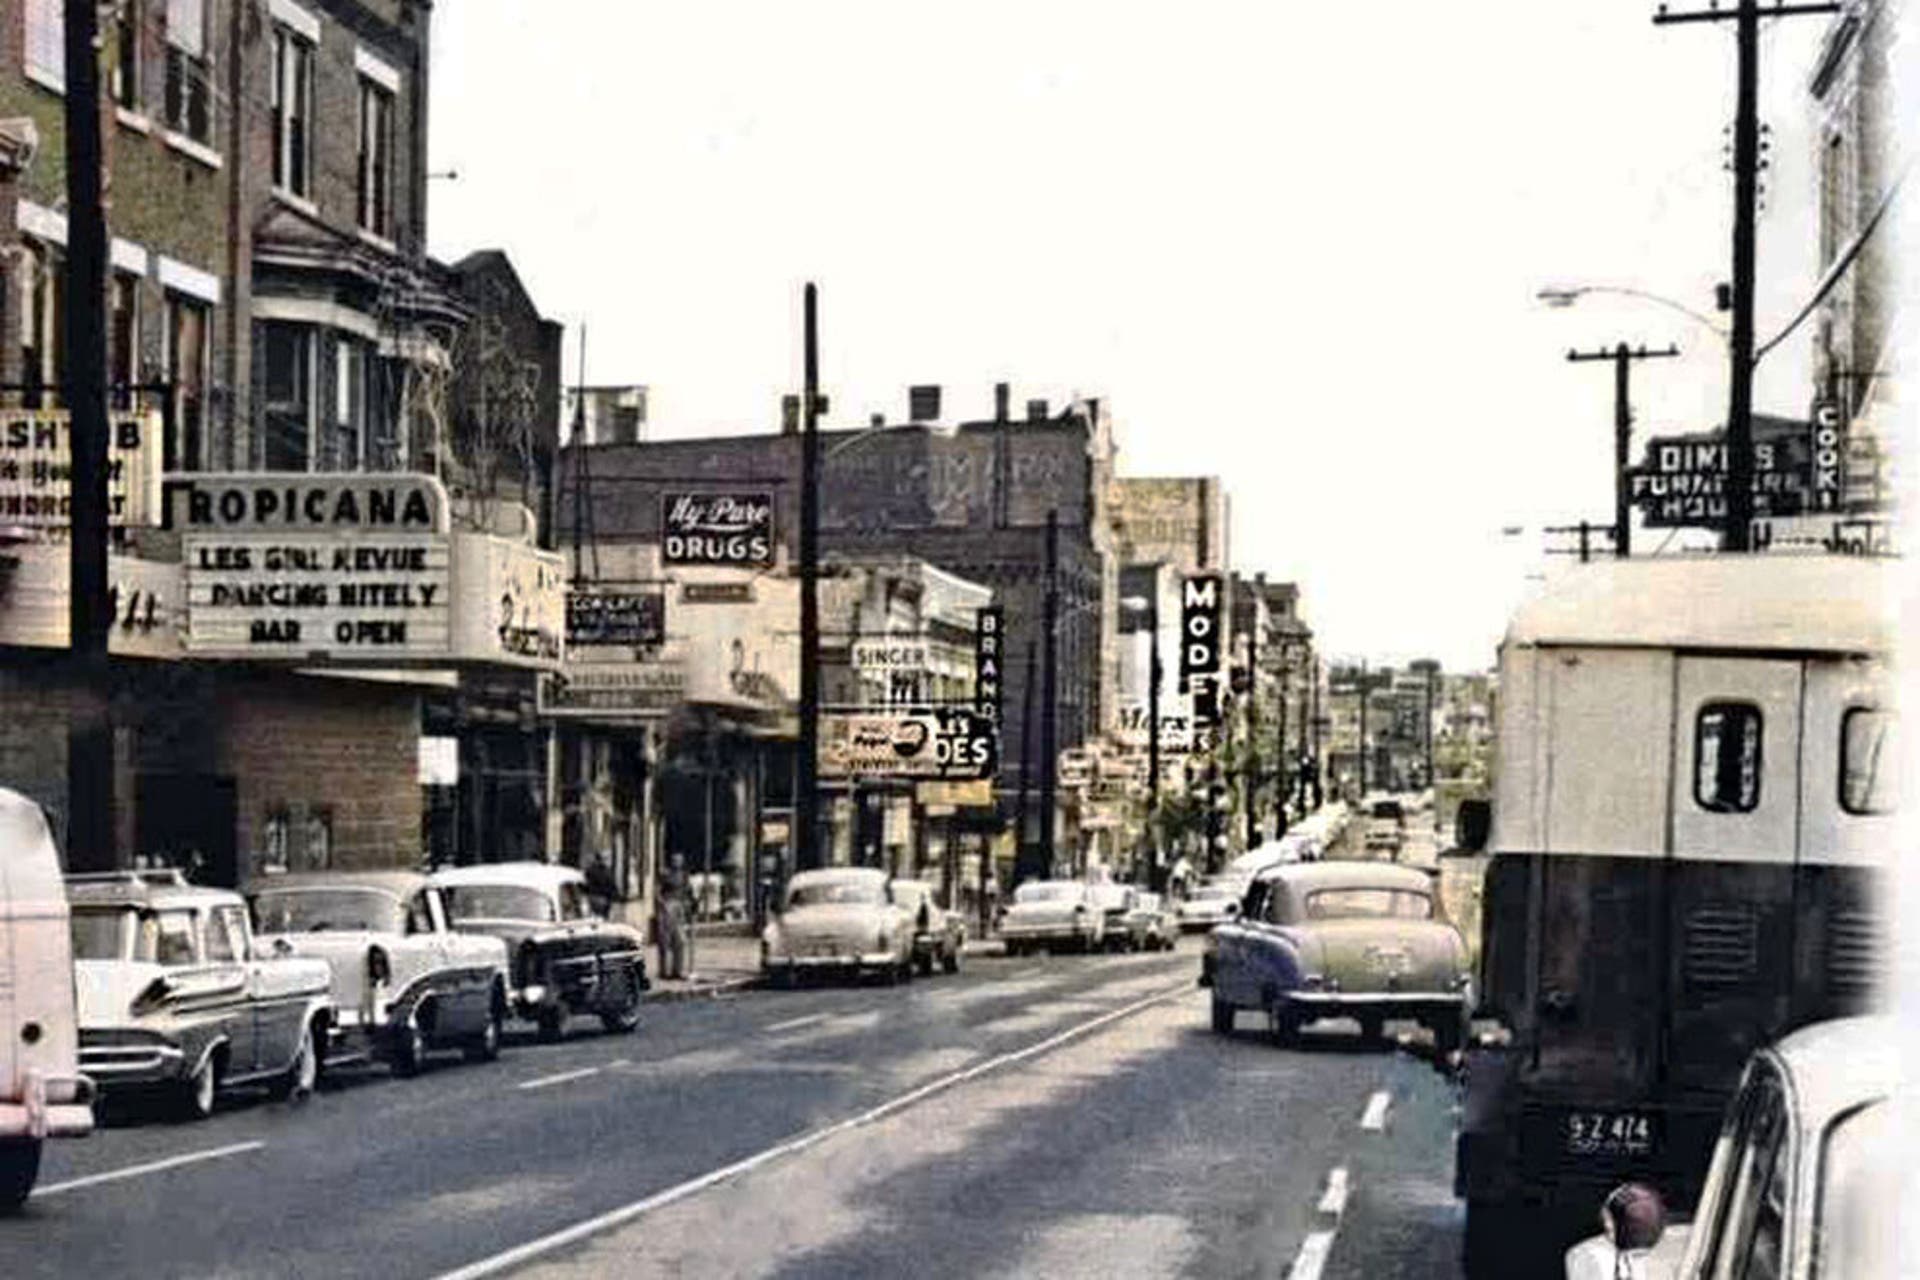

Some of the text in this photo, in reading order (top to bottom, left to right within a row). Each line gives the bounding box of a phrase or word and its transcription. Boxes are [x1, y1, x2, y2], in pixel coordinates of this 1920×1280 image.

[162, 481, 430, 529] TROPICANA
[200, 547, 250, 571] LES
[331, 547, 427, 571] REVUE
[666, 536, 769, 561] DRUGS
[211, 582, 437, 608] DANCING NITELY
[251, 620, 406, 644] BAR OPEN
[857, 648, 925, 665] SINGER
